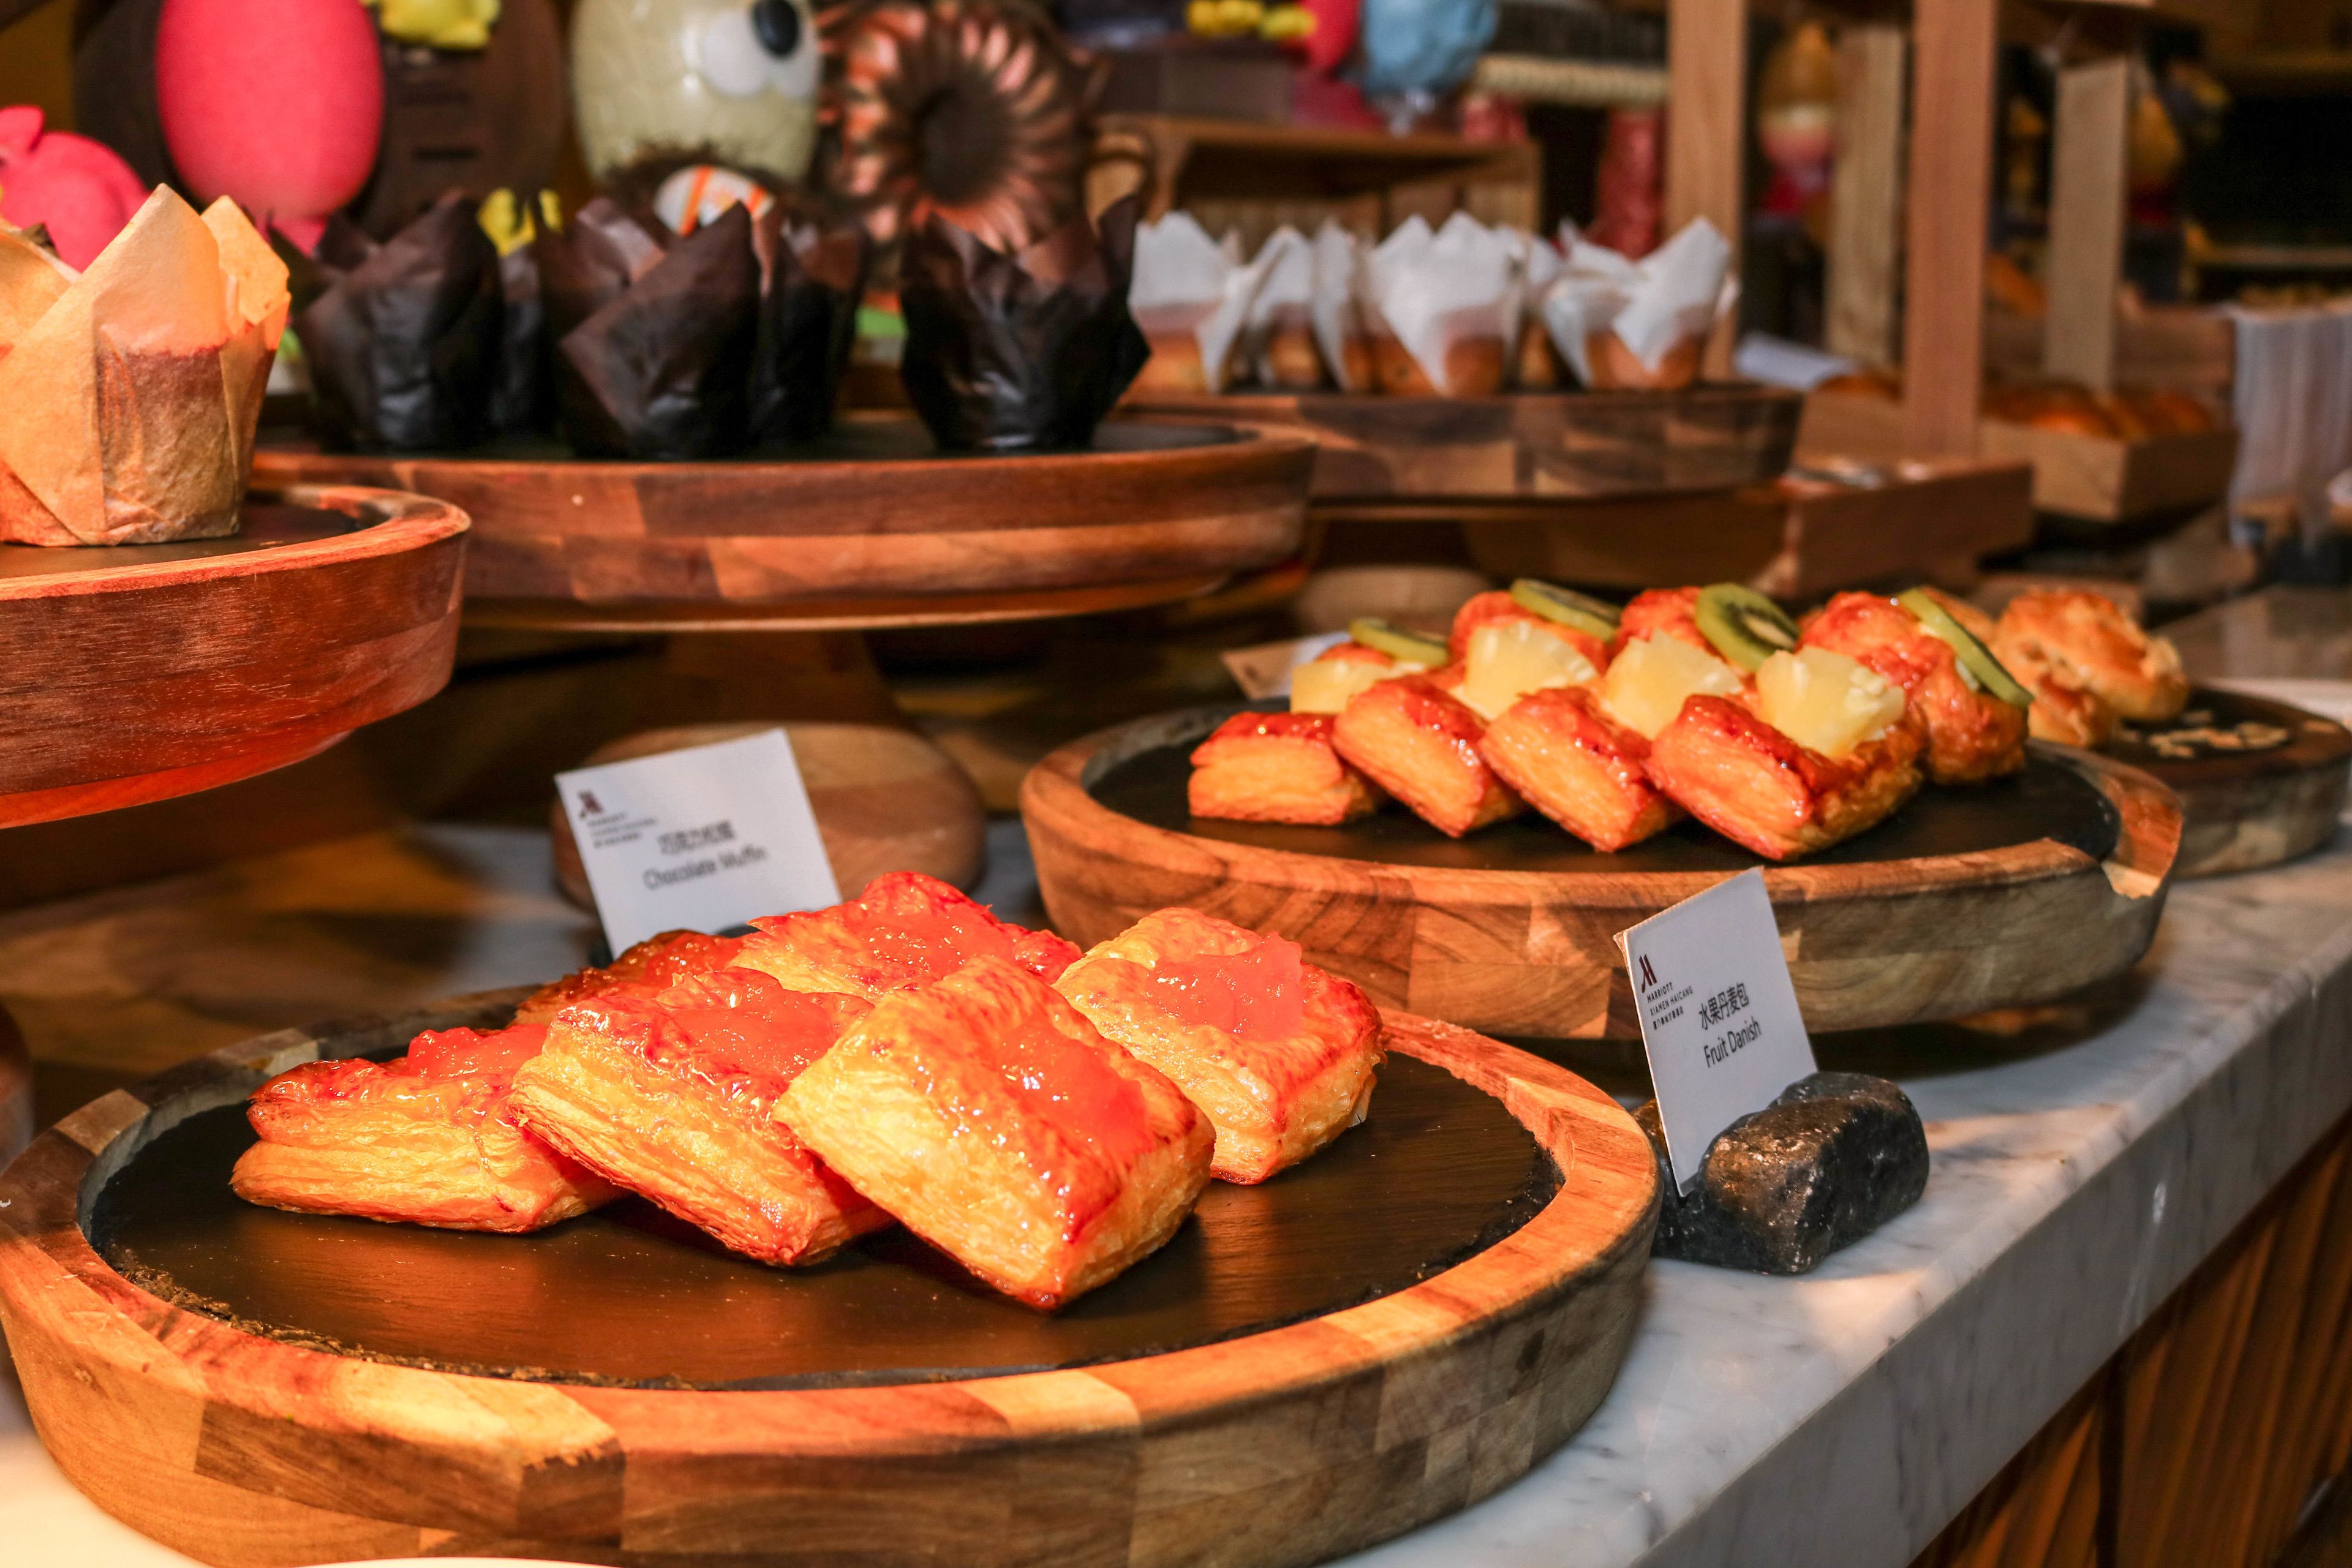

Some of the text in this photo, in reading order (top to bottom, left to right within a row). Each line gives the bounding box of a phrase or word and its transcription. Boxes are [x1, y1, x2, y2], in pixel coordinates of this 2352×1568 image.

[1646, 982, 1673, 1003] MARRIOTT
[1649, 1000, 1670, 1017] XIAMEN
[1698, 982, 1749, 1030] 水果丹麦包
[1703, 1015, 1762, 1068] Fruit Danish
